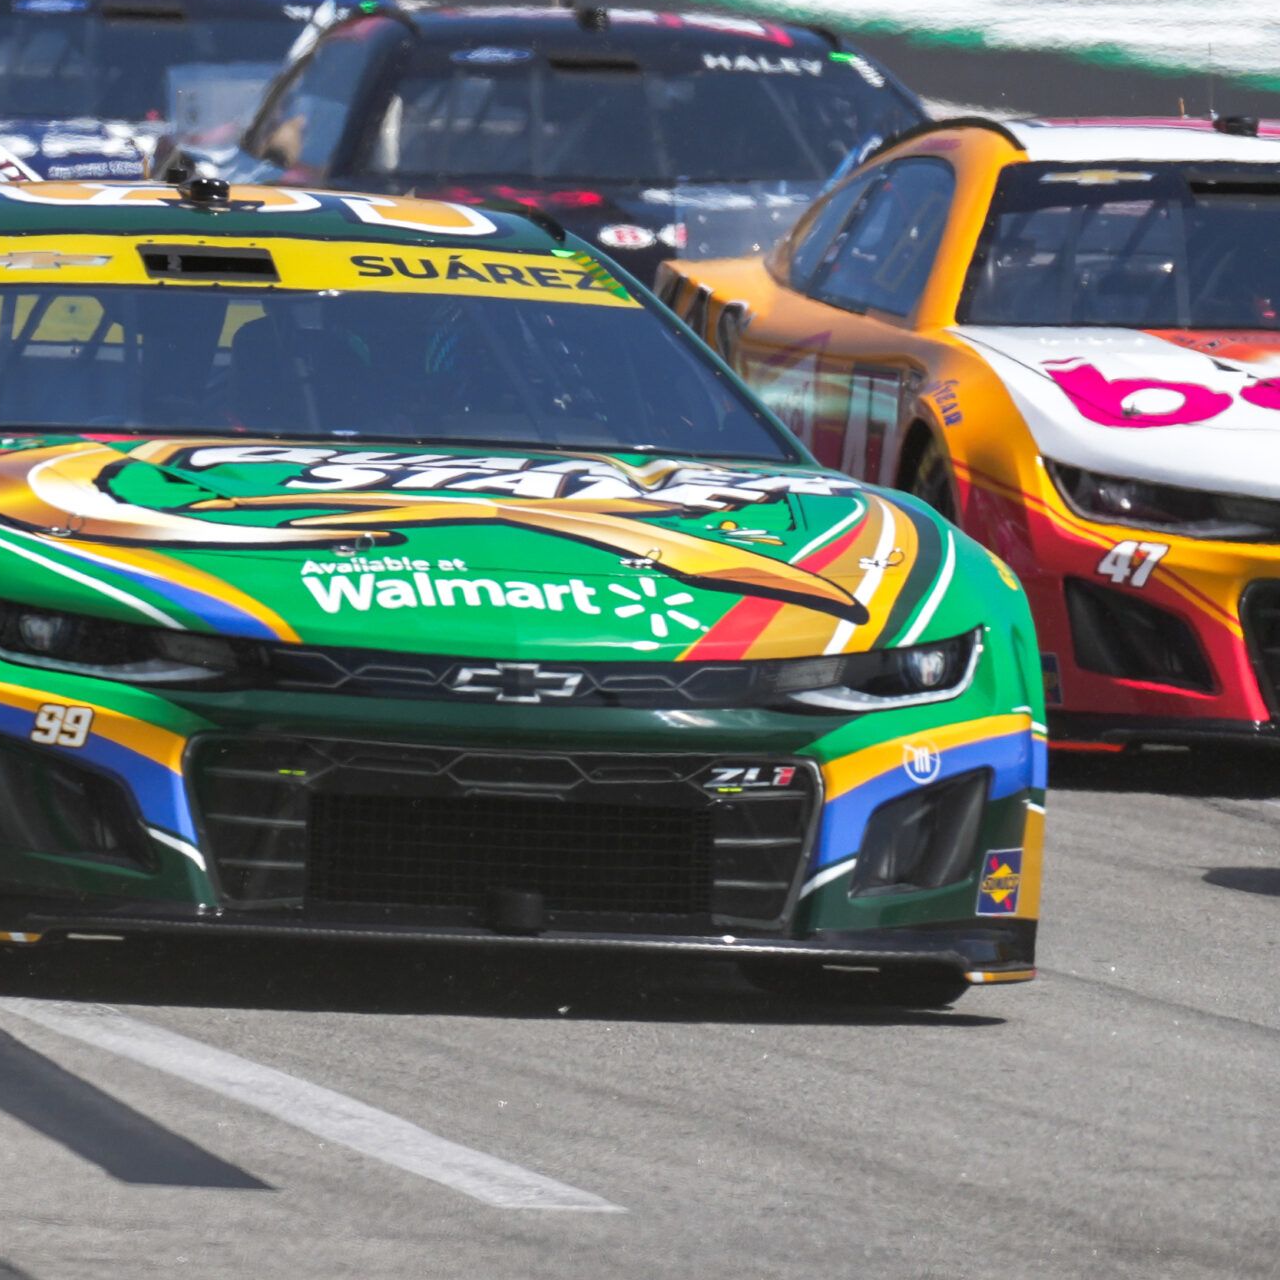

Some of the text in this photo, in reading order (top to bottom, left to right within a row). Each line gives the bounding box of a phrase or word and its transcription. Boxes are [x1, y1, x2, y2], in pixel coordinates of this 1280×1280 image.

[702, 53, 823, 77] HALEY
[350, 254, 612, 291] SUÁREZ
[301, 557, 467, 575] Available at
[1096, 540, 1171, 587] 47
[302, 573, 601, 614] Walmart
[31, 703, 95, 748] 99
